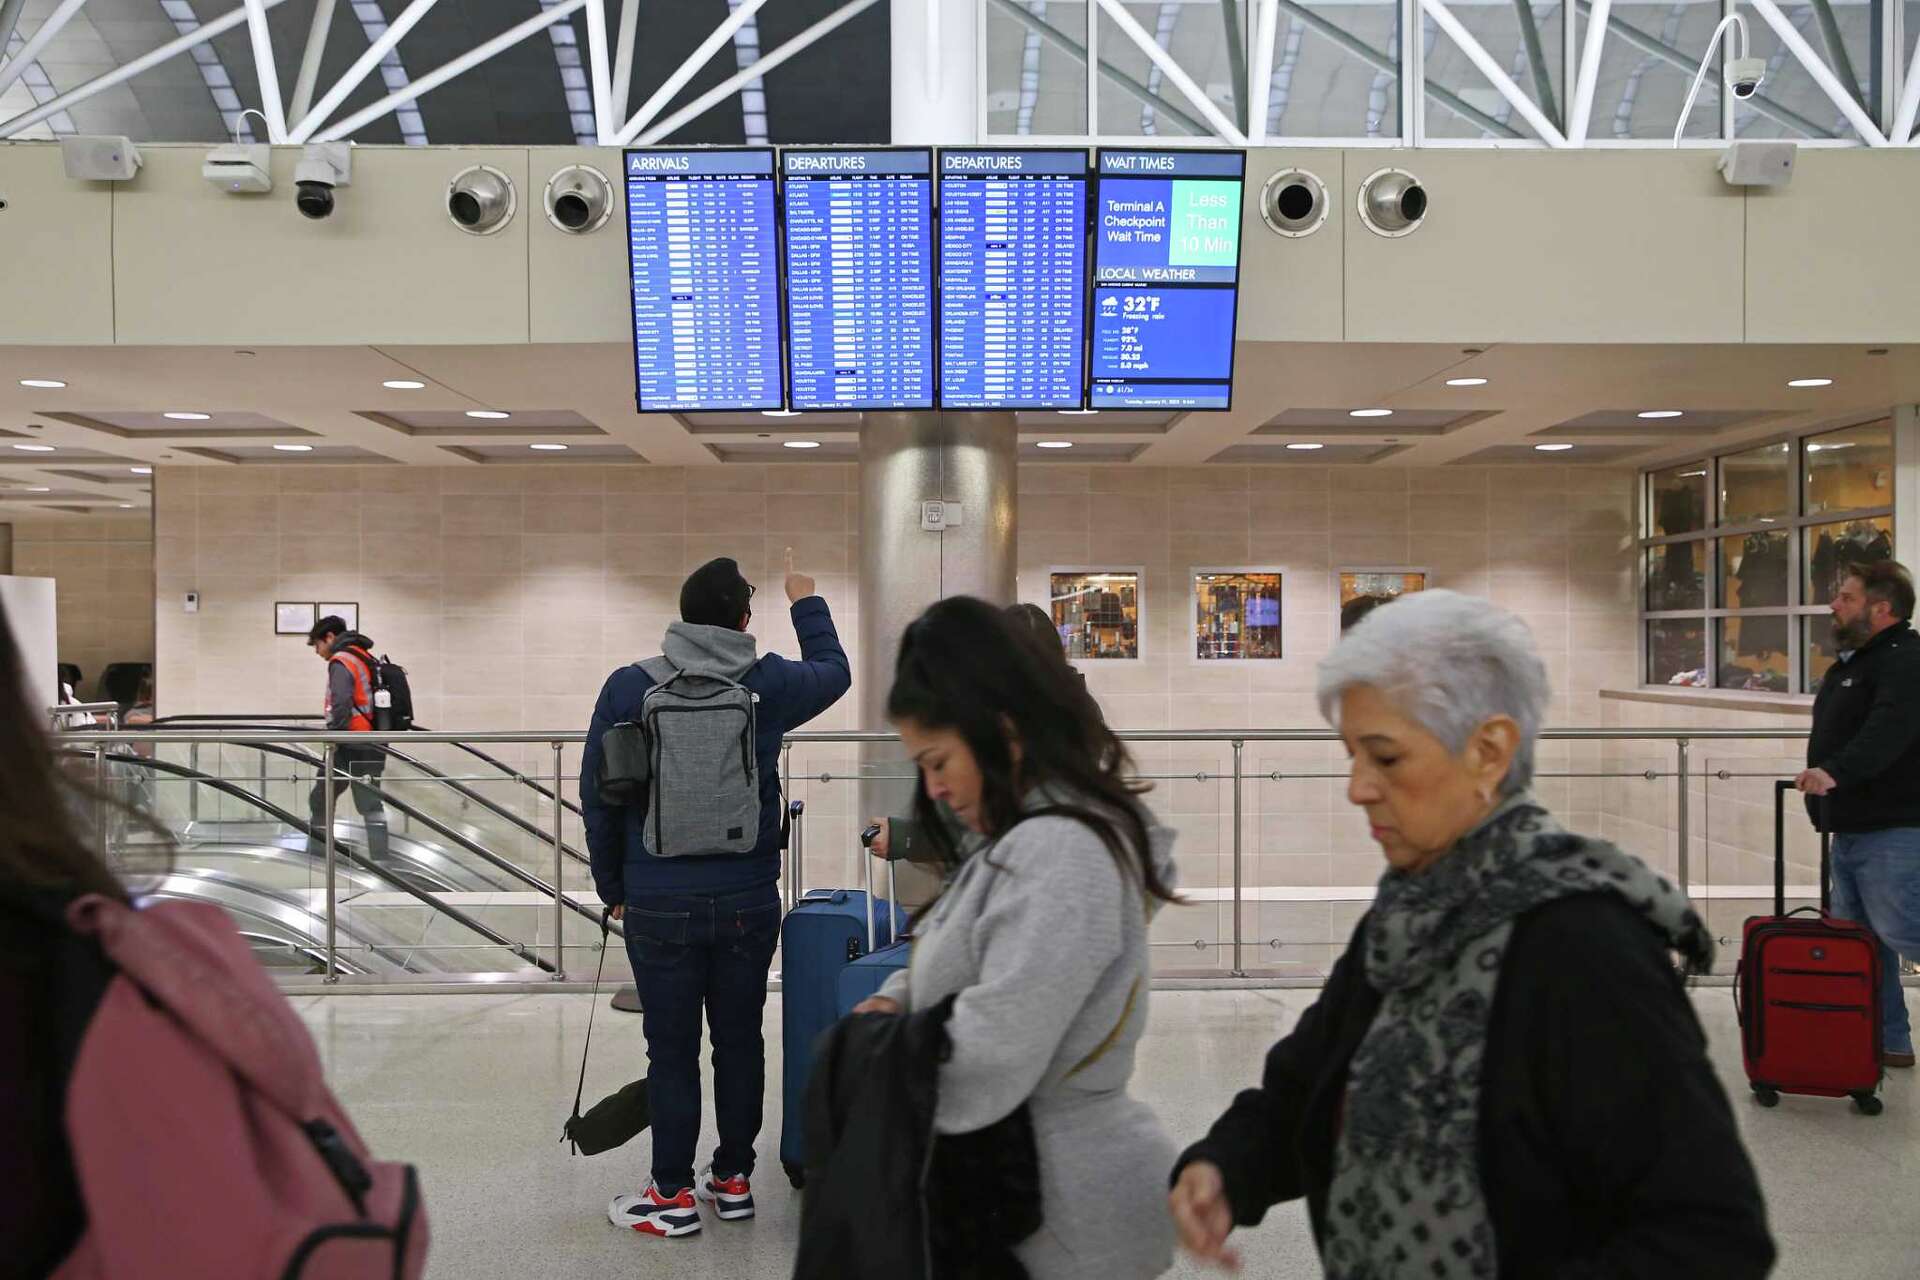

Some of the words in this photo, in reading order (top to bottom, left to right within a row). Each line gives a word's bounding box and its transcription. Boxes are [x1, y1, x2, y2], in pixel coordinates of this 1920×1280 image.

[631, 156, 689, 170] ARRIVALS
[788, 156, 866, 170] DEPARTURES
[946, 156, 1022, 170] DEPARTURES
[1105, 156, 1136, 168] WAIT
[1139, 157, 1174, 170] TIMES
[1108, 200, 1152, 212] Terminal
[1156, 202, 1164, 212] A
[1190, 192, 1227, 206] Less
[1104, 216, 1165, 228] Checkpoint
[1186, 213, 1227, 229] Than
[1108, 230, 1132, 242] Wait
[1134, 230, 1160, 242] Time
[1182, 236, 1199, 252] 10
[1204, 236, 1232, 252] Min
[1100, 268, 1136, 280] LOCAL
[1142, 268, 1196, 280] WEATHER
[1124, 296, 1160, 312] 32°F
[1122, 312, 1149, 321] Freezing
